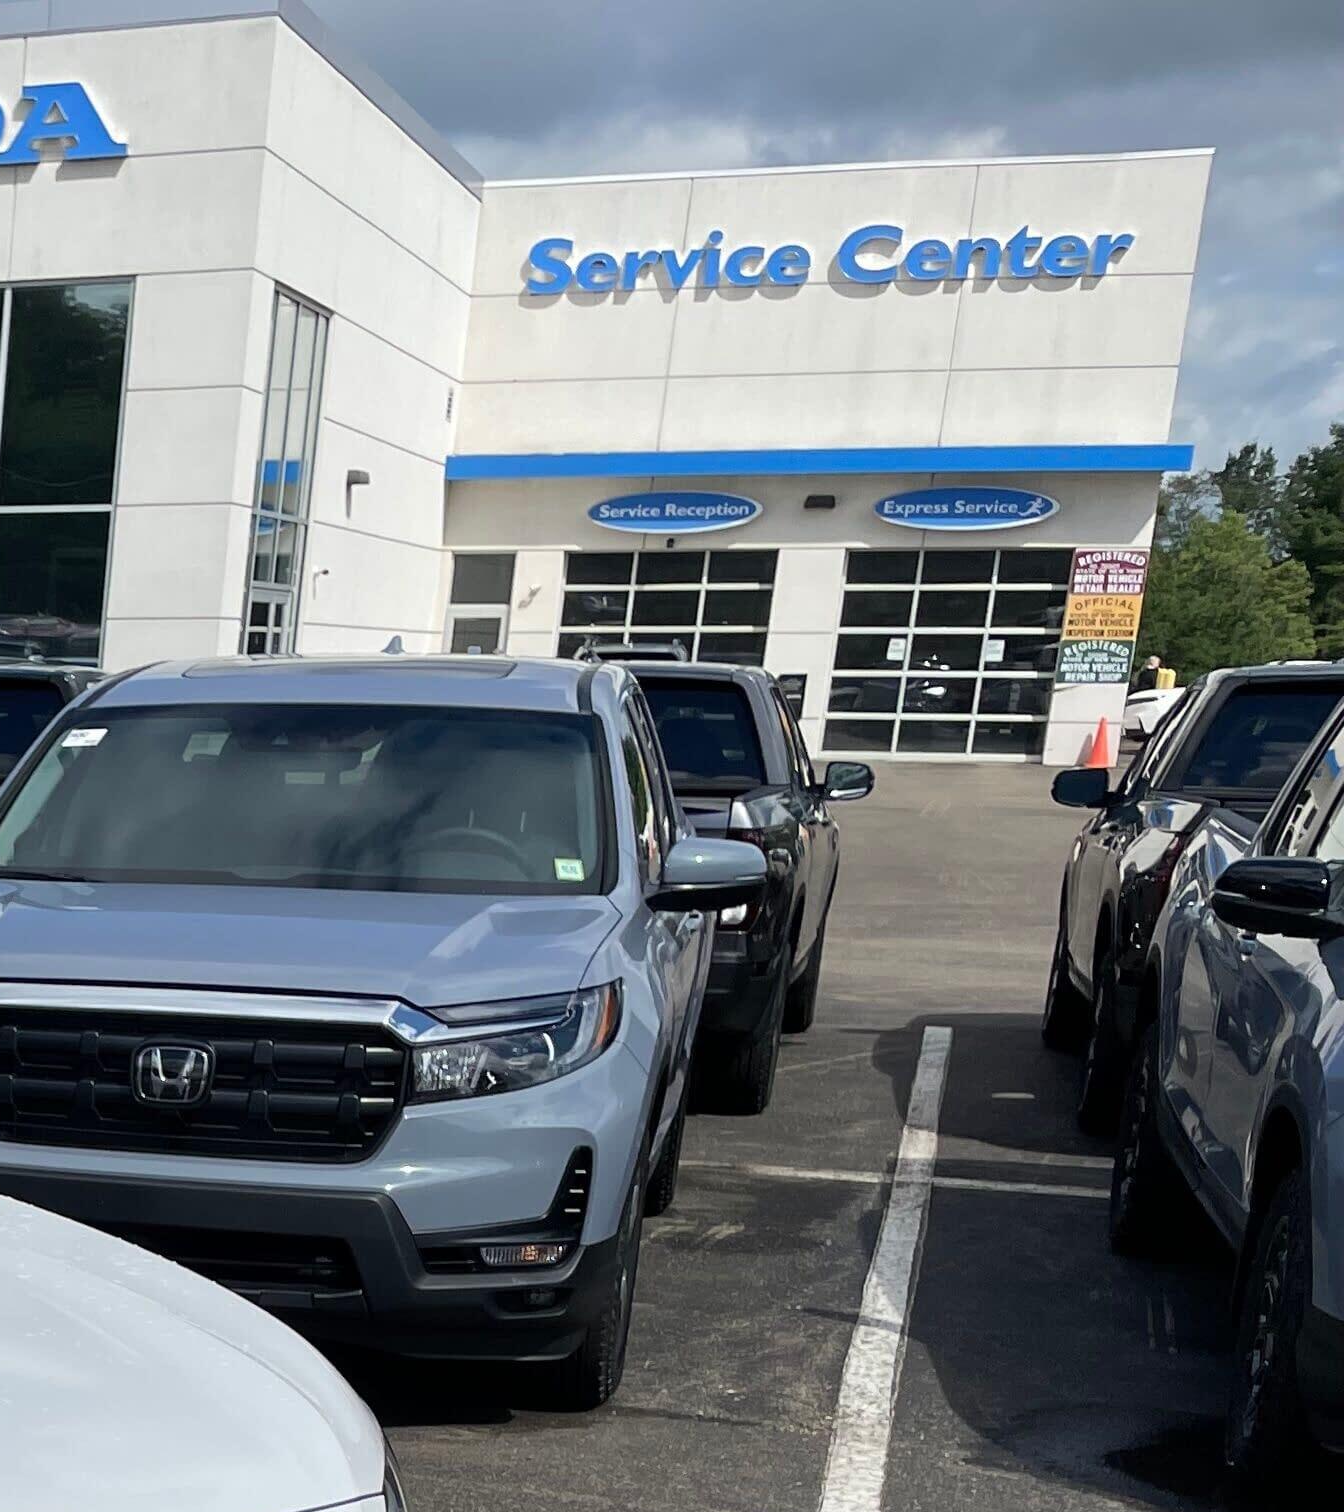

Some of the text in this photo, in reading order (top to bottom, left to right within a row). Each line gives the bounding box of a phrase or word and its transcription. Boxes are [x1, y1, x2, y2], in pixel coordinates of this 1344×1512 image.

[526, 224, 1134, 296] Service Center
[599, 503, 749, 519] Service Reception
[883, 500, 1018, 517] Express Service
[1077, 551, 1146, 567] REGISTERED
[1074, 574, 1144, 583] MOTOR VEHICLE
[1074, 584, 1141, 593] RETAIL DEALER
[1074, 597, 1135, 611] OFFICIAL
[1068, 618, 1134, 627] MOTOR VEHICLE
[1063, 640, 1130, 657] REGISTERED
[1060, 663, 1128, 672] MOTOR VEHICLE
